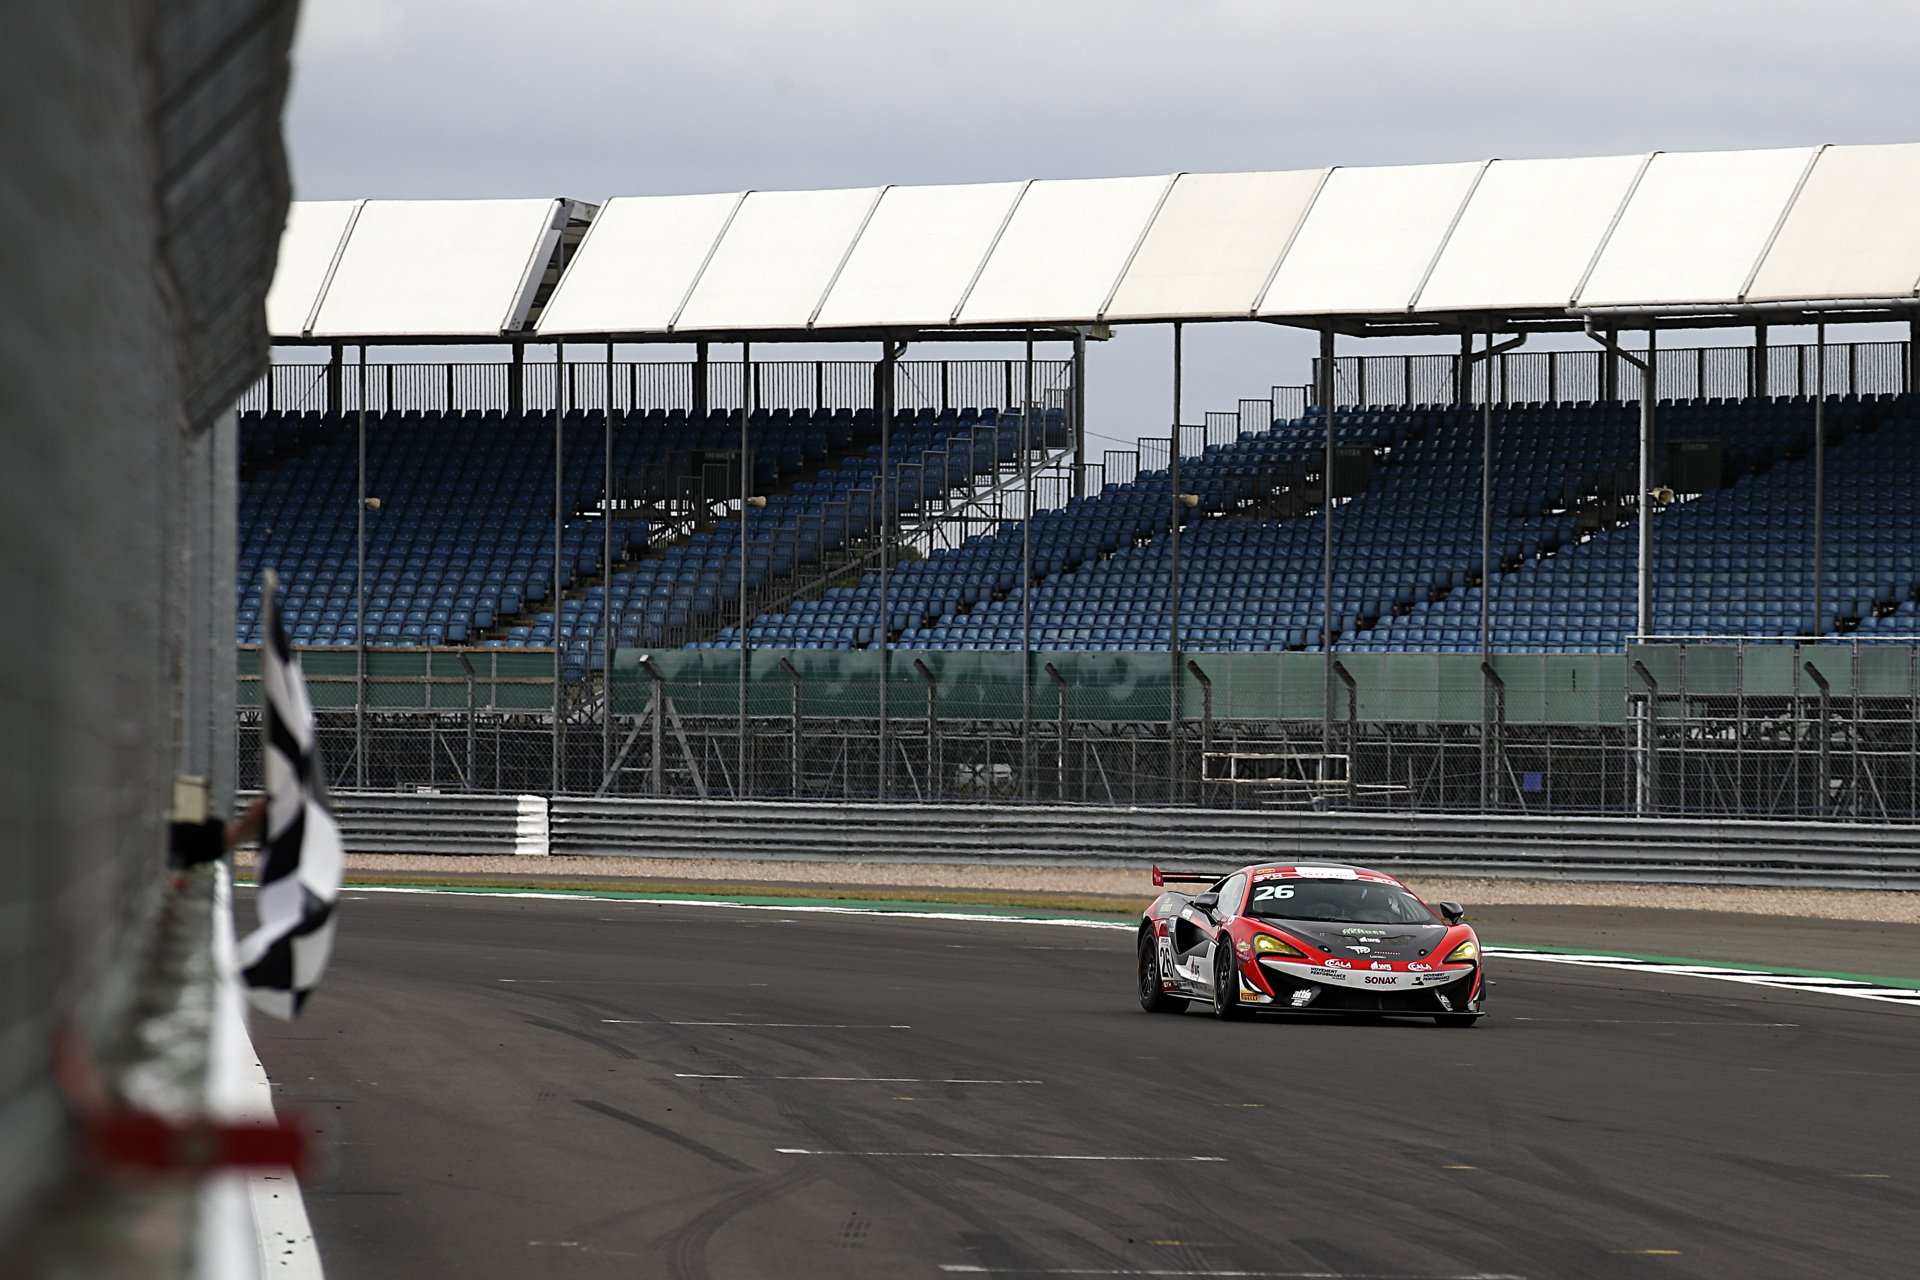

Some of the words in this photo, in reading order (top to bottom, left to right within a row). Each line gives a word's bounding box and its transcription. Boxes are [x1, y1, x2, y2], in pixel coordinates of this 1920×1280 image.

[1254, 885, 1295, 901] 26
[1160, 947, 1173, 978] 26
[1325, 959, 1351, 968] CALA
[1408, 962, 1432, 971] CALA
[1365, 976, 1397, 985] SONAX
